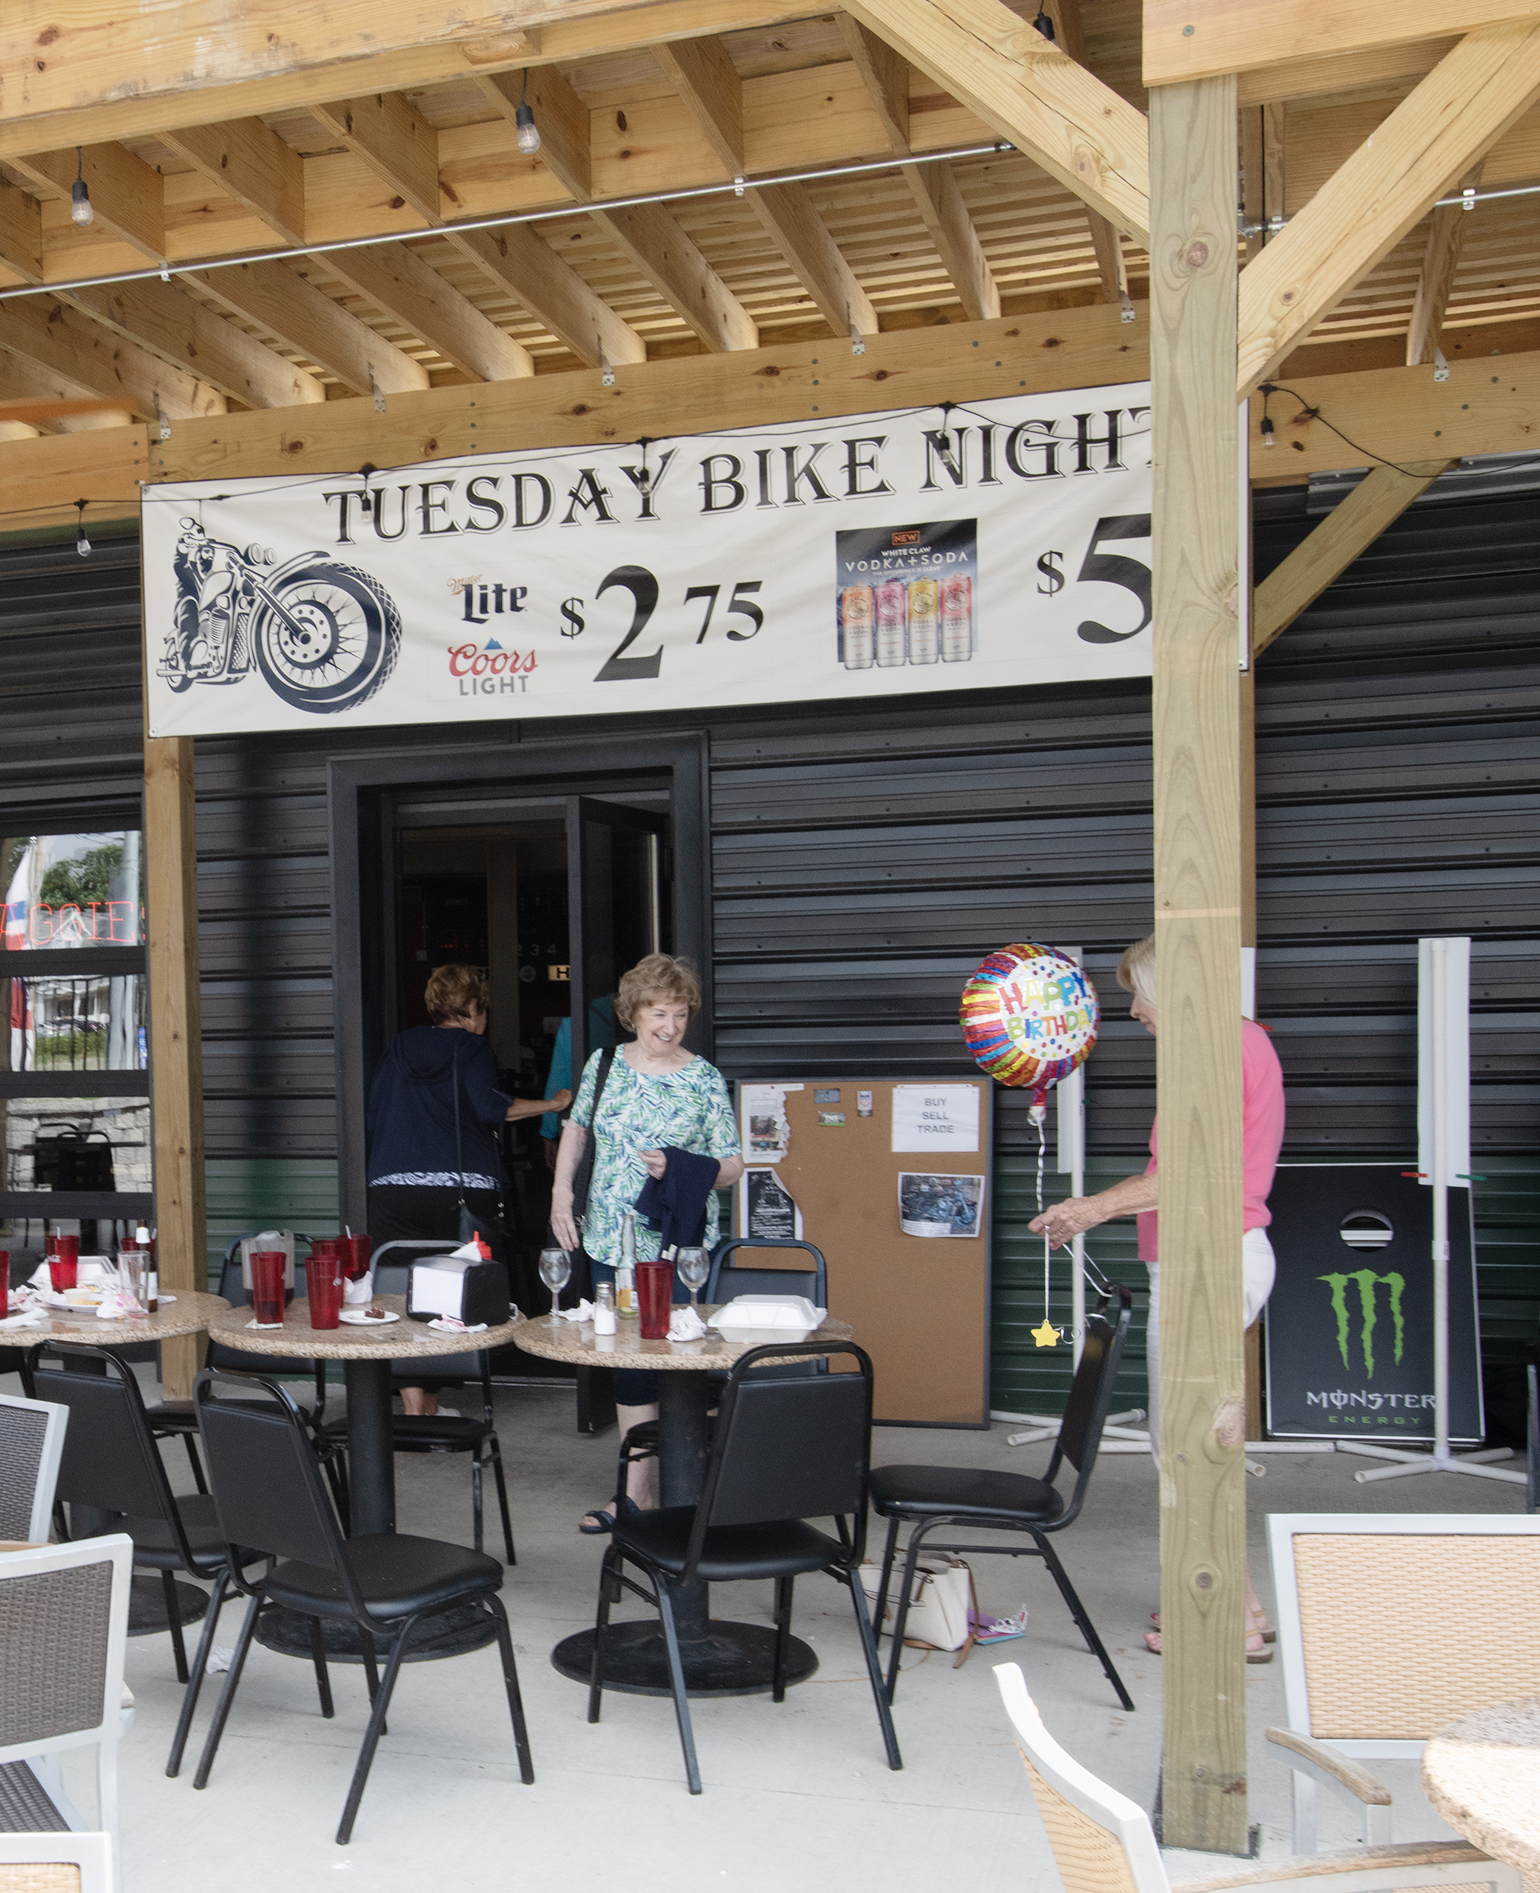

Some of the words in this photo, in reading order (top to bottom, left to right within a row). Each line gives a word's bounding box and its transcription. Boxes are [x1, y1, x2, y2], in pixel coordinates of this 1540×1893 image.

[322, 446, 681, 546] TUESDAY
[697, 434, 897, 517] BIKE
[892, 532, 920, 544] NEW
[881, 548, 908, 558] WHITE
[460, 583, 528, 625] Lite
[446, 642, 539, 677] Coors
[458, 674, 530, 697] LIGHT
[997, 971, 1088, 1016] HAPPY
[1006, 1003, 1094, 1041] BIRTHDAY
[924, 1097, 948, 1107] BUY
[921, 1111, 949, 1120] SELL
[917, 1124, 955, 1134] TRADE
[1305, 1388, 1437, 1411] MONSTER
[1328, 1415, 1422, 1425] ENERGY
